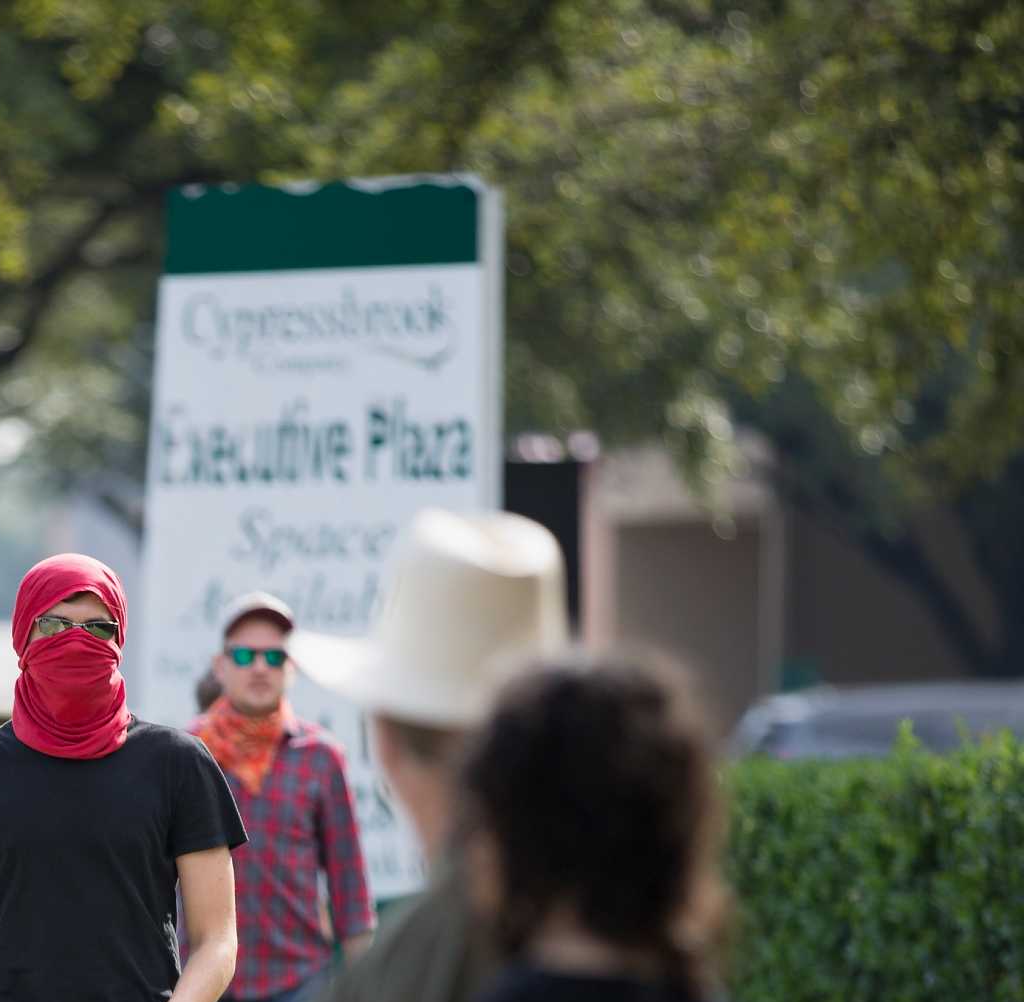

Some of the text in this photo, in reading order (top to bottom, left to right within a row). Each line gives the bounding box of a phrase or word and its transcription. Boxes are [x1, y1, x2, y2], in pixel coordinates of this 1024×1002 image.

[181, 284, 446, 361] Cypressbrook
[158, 394, 473, 485] Executive Plaza
[230, 506, 397, 572] Space
